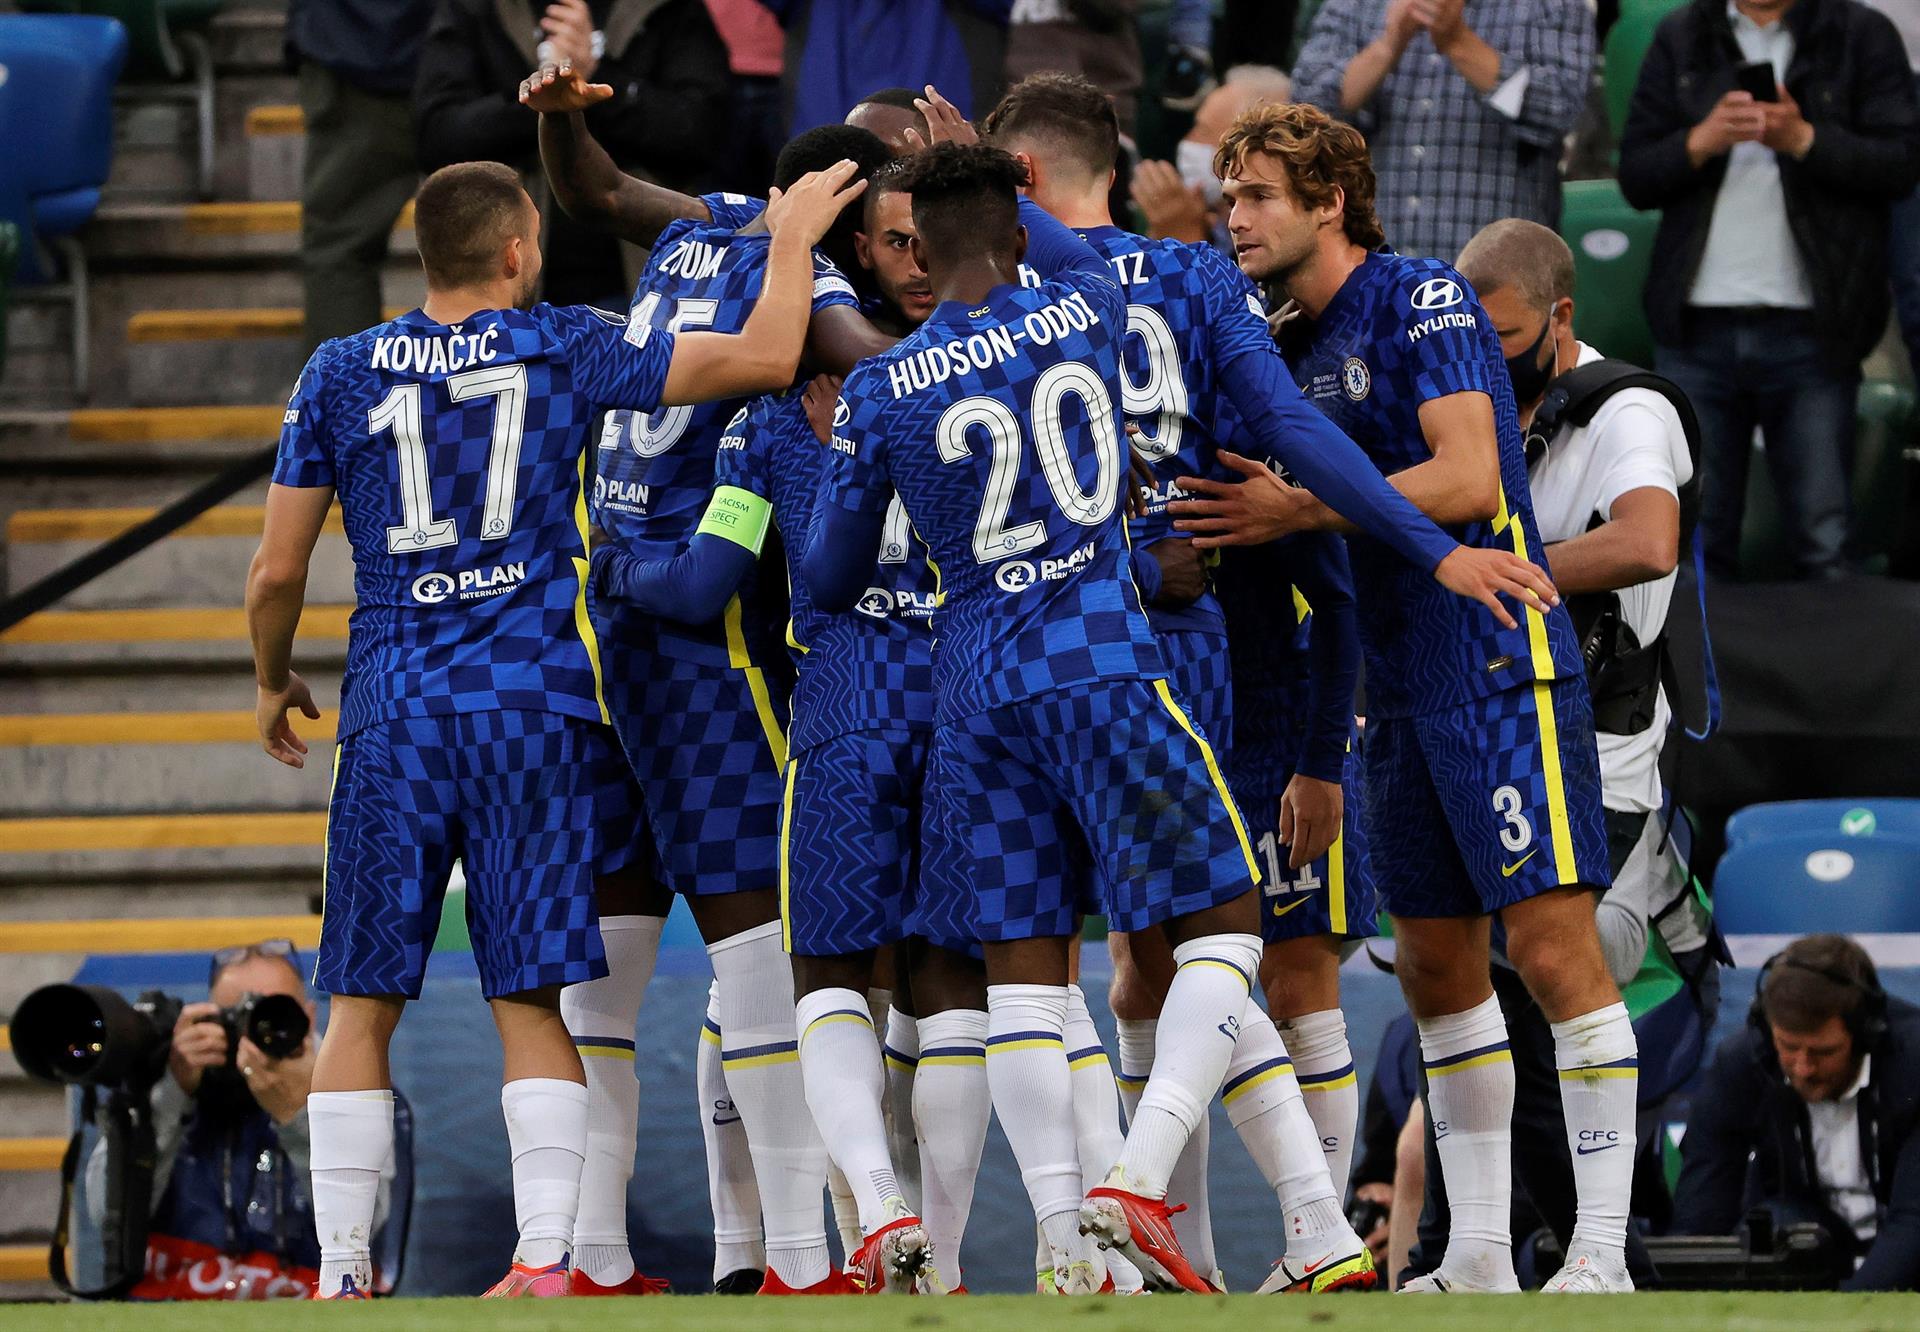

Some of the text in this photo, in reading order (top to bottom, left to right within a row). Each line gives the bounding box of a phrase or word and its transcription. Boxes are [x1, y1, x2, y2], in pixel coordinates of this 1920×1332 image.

[658, 240, 730, 281] ZOUM
[1106, 251, 1149, 286] TZ
[967, 305, 991, 319] CFC
[1407, 313, 1477, 343] HYUNDA
[370, 323, 499, 374] KOVAČIĆ
[887, 292, 1100, 400] HUDSON-ODOI
[367, 363, 528, 555] 17
[935, 361, 1120, 564] 20
[608, 480, 649, 505] PLAN
[1140, 480, 1196, 503] PLA
[458, 561, 526, 591] PLAN
[1040, 541, 1095, 580] PLAN
[895, 590, 937, 609] PLA
[1492, 785, 1534, 853] 3
[1578, 1130, 1619, 1141] CFC
